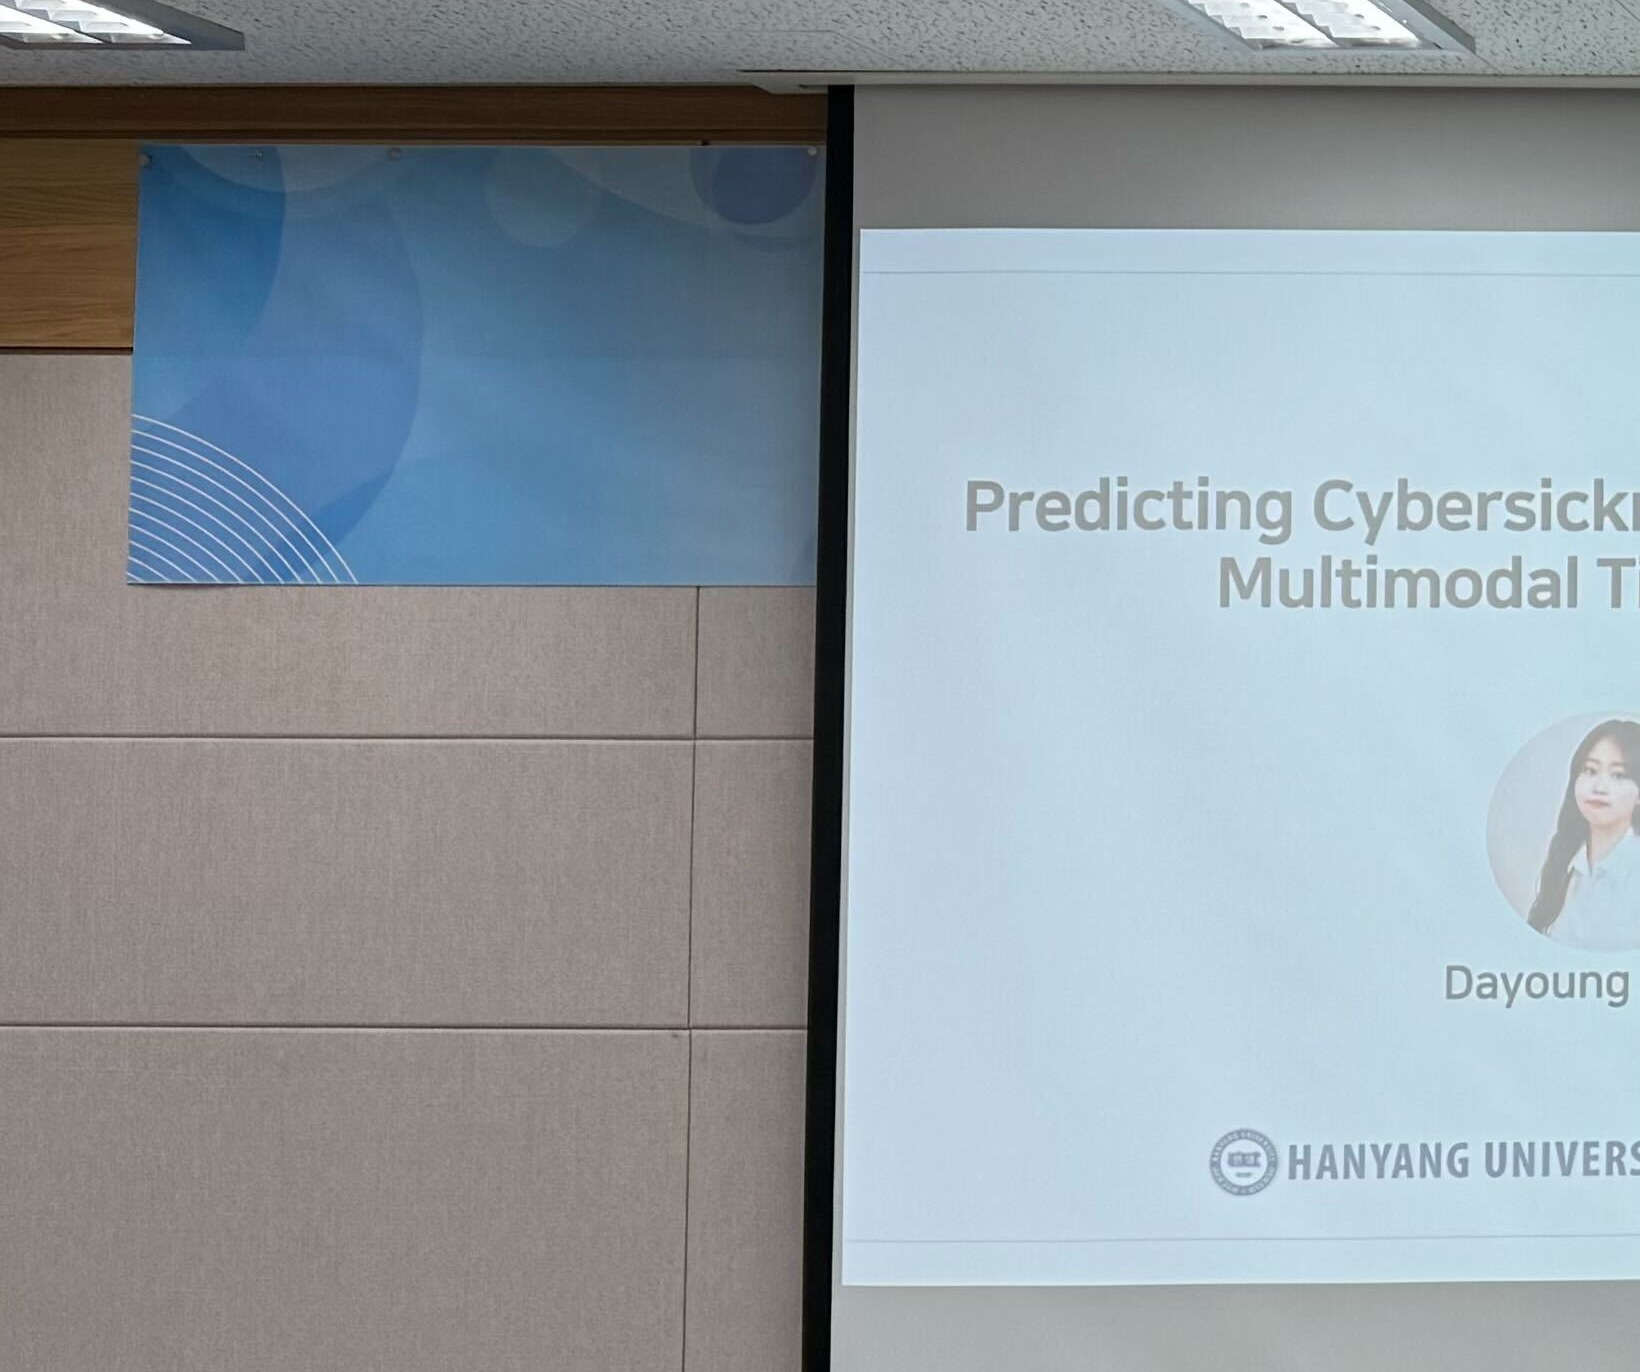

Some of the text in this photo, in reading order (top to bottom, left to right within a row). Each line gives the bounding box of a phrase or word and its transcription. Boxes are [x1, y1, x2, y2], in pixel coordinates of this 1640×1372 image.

[966, 476, 1292, 546] Predicting
[1219, 554, 1578, 609] Multimodal
[1444, 964, 1630, 1008] Dayoung
[1288, 1142, 1470, 1181] HANYANG
